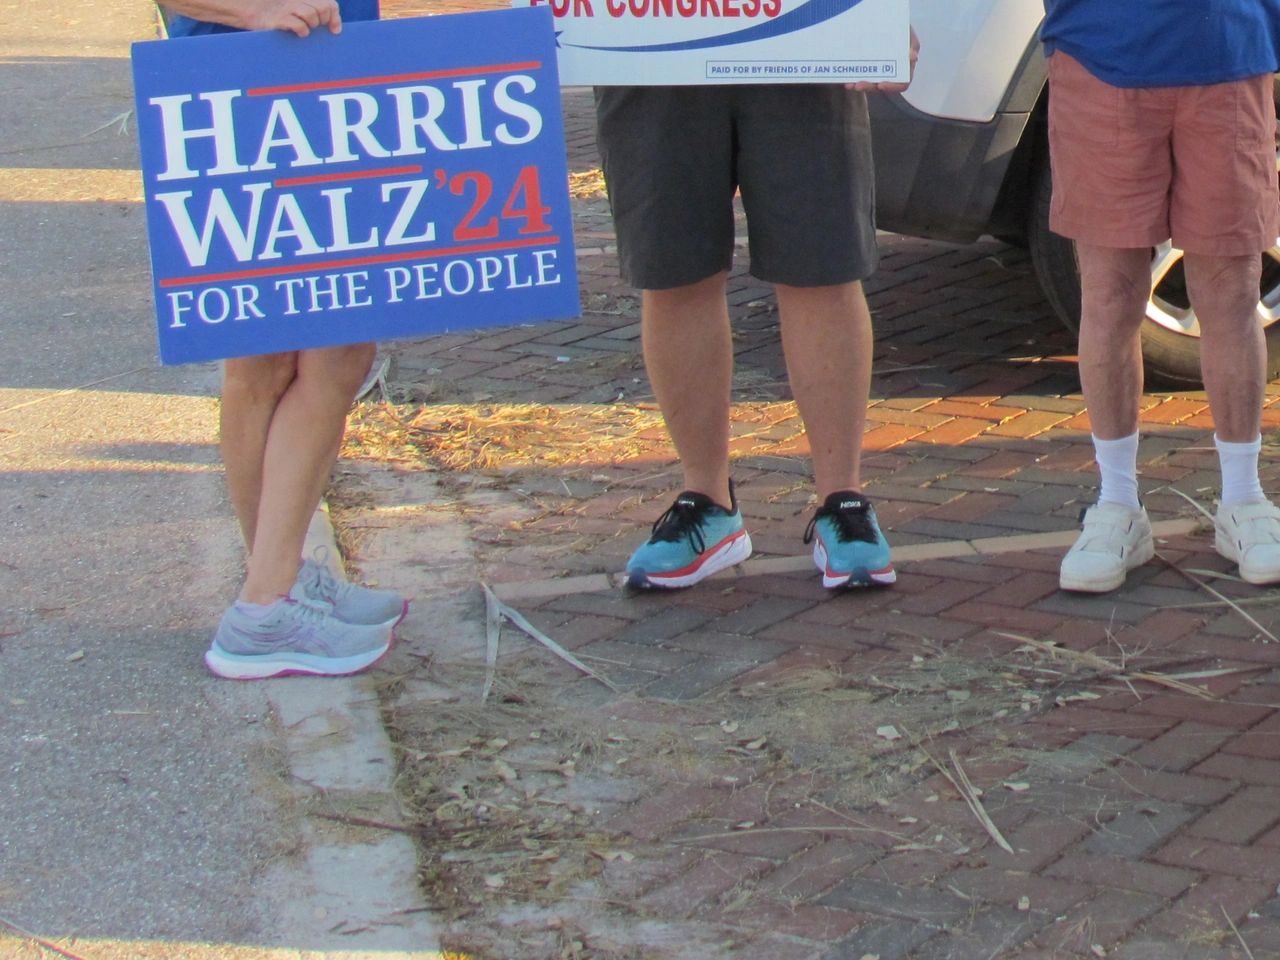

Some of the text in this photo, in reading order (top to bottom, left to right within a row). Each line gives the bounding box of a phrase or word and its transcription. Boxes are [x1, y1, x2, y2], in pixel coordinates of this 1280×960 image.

[711, 64, 894, 74] PAID FOR BY FRIENDS OF JAN SCHNEIDER (D)
[149, 74, 544, 181] HARRIS
[154, 165, 553, 267] WALZ '24
[166, 249, 561, 329] FOR THE PEOPLE
